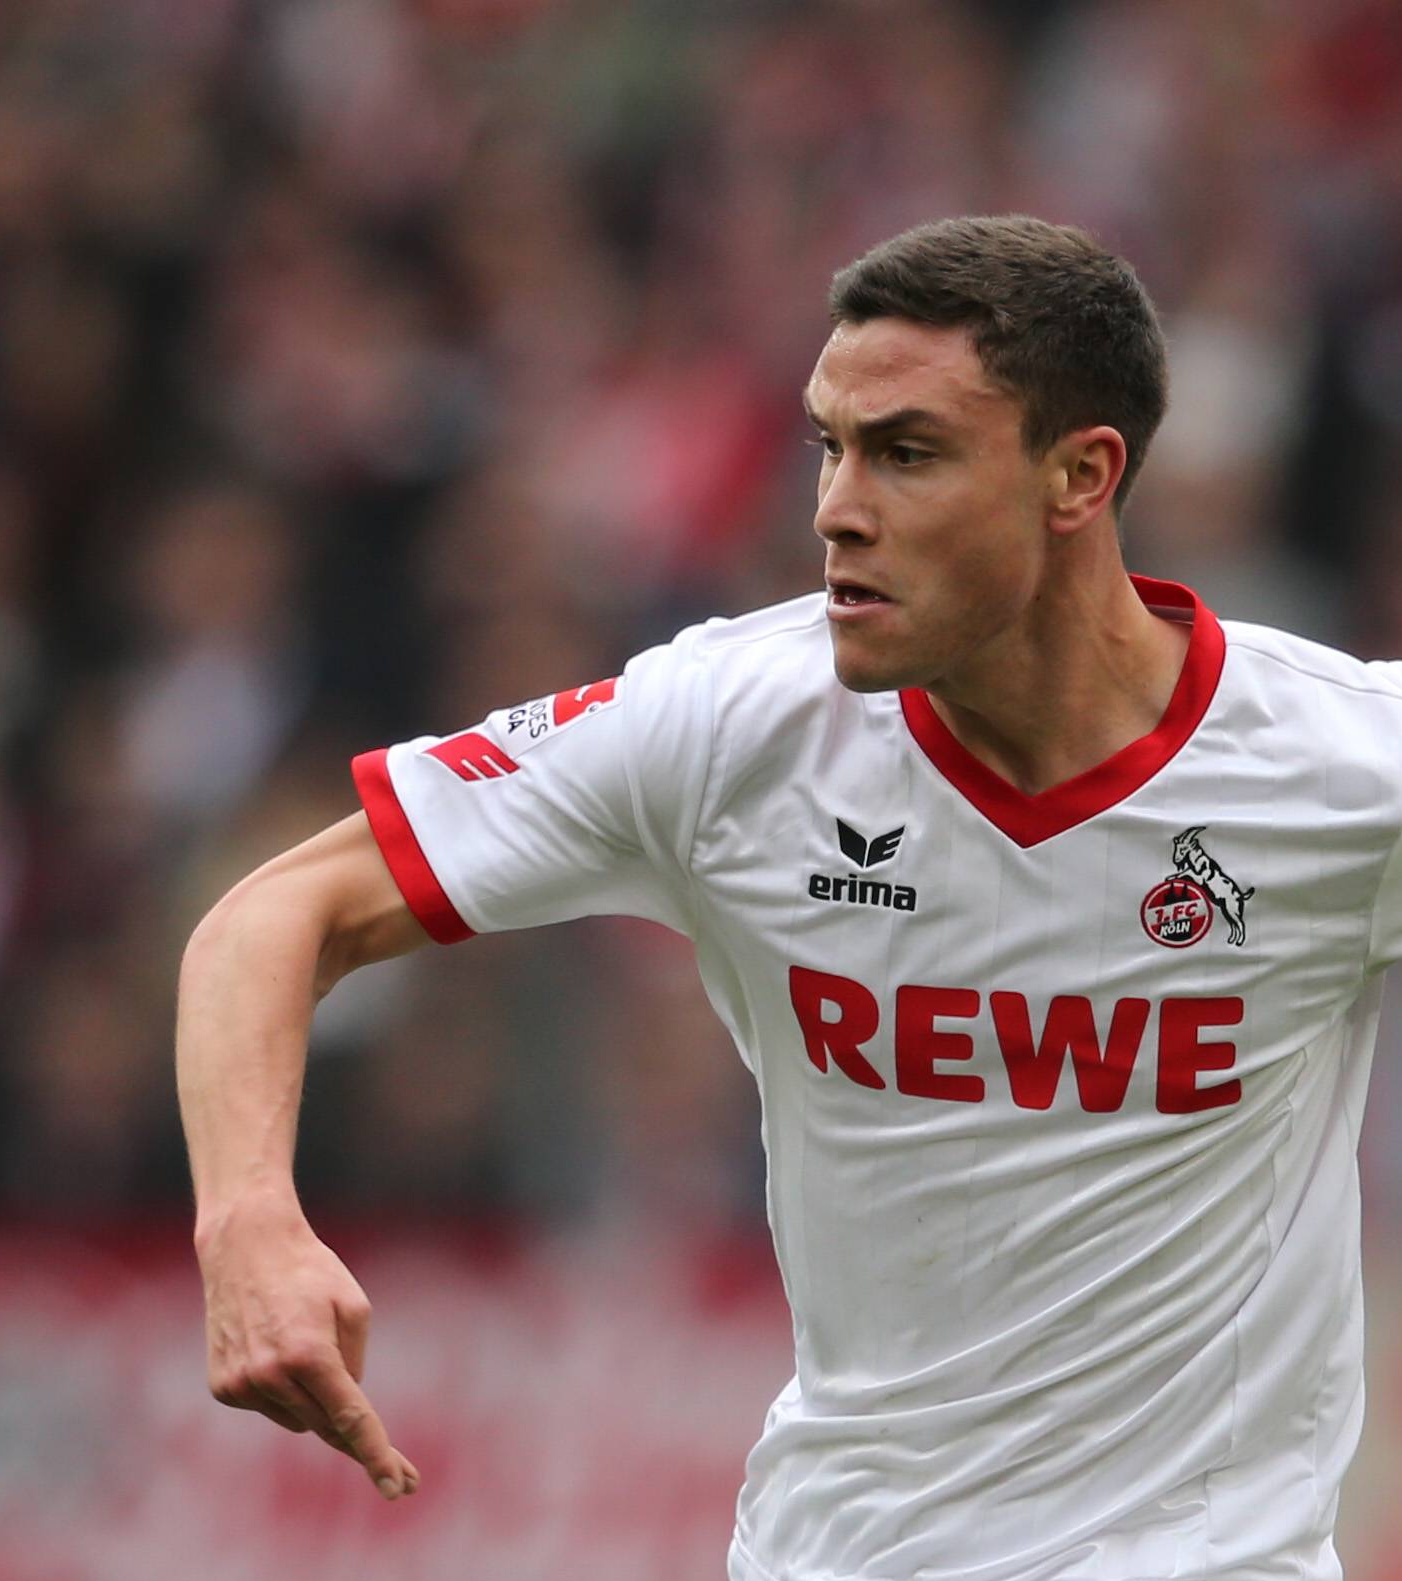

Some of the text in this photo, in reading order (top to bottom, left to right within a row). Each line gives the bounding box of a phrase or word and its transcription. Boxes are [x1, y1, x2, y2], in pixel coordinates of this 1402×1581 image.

[808, 873, 916, 912] erima
[1160, 921, 1191, 937] KÖLN
[789, 965, 1244, 1114] REWE
